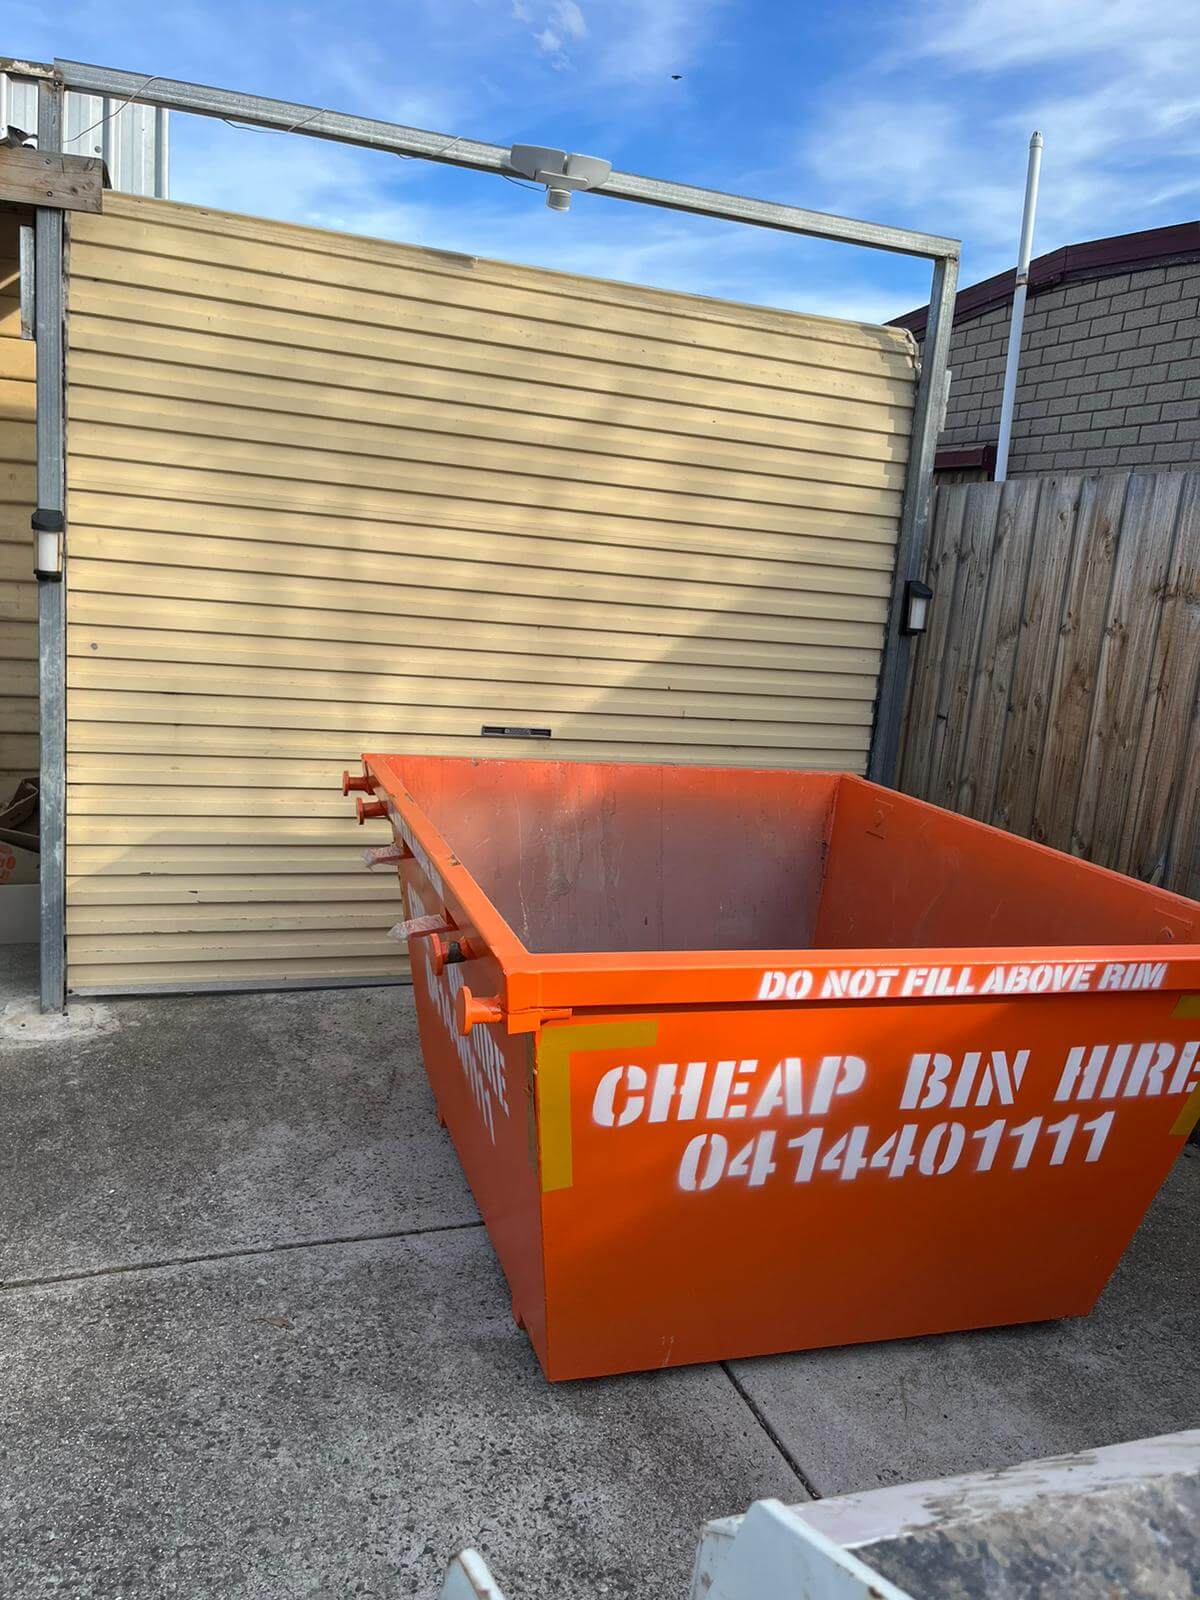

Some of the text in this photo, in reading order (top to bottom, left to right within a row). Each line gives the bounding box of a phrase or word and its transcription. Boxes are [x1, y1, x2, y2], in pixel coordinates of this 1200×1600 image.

[757, 962, 1168, 1000] DO NOT FILL ABOVE RIM
[592, 1041, 1200, 1127] CHEAP BIN HIRE
[677, 1111, 1115, 1192] 0414401111
